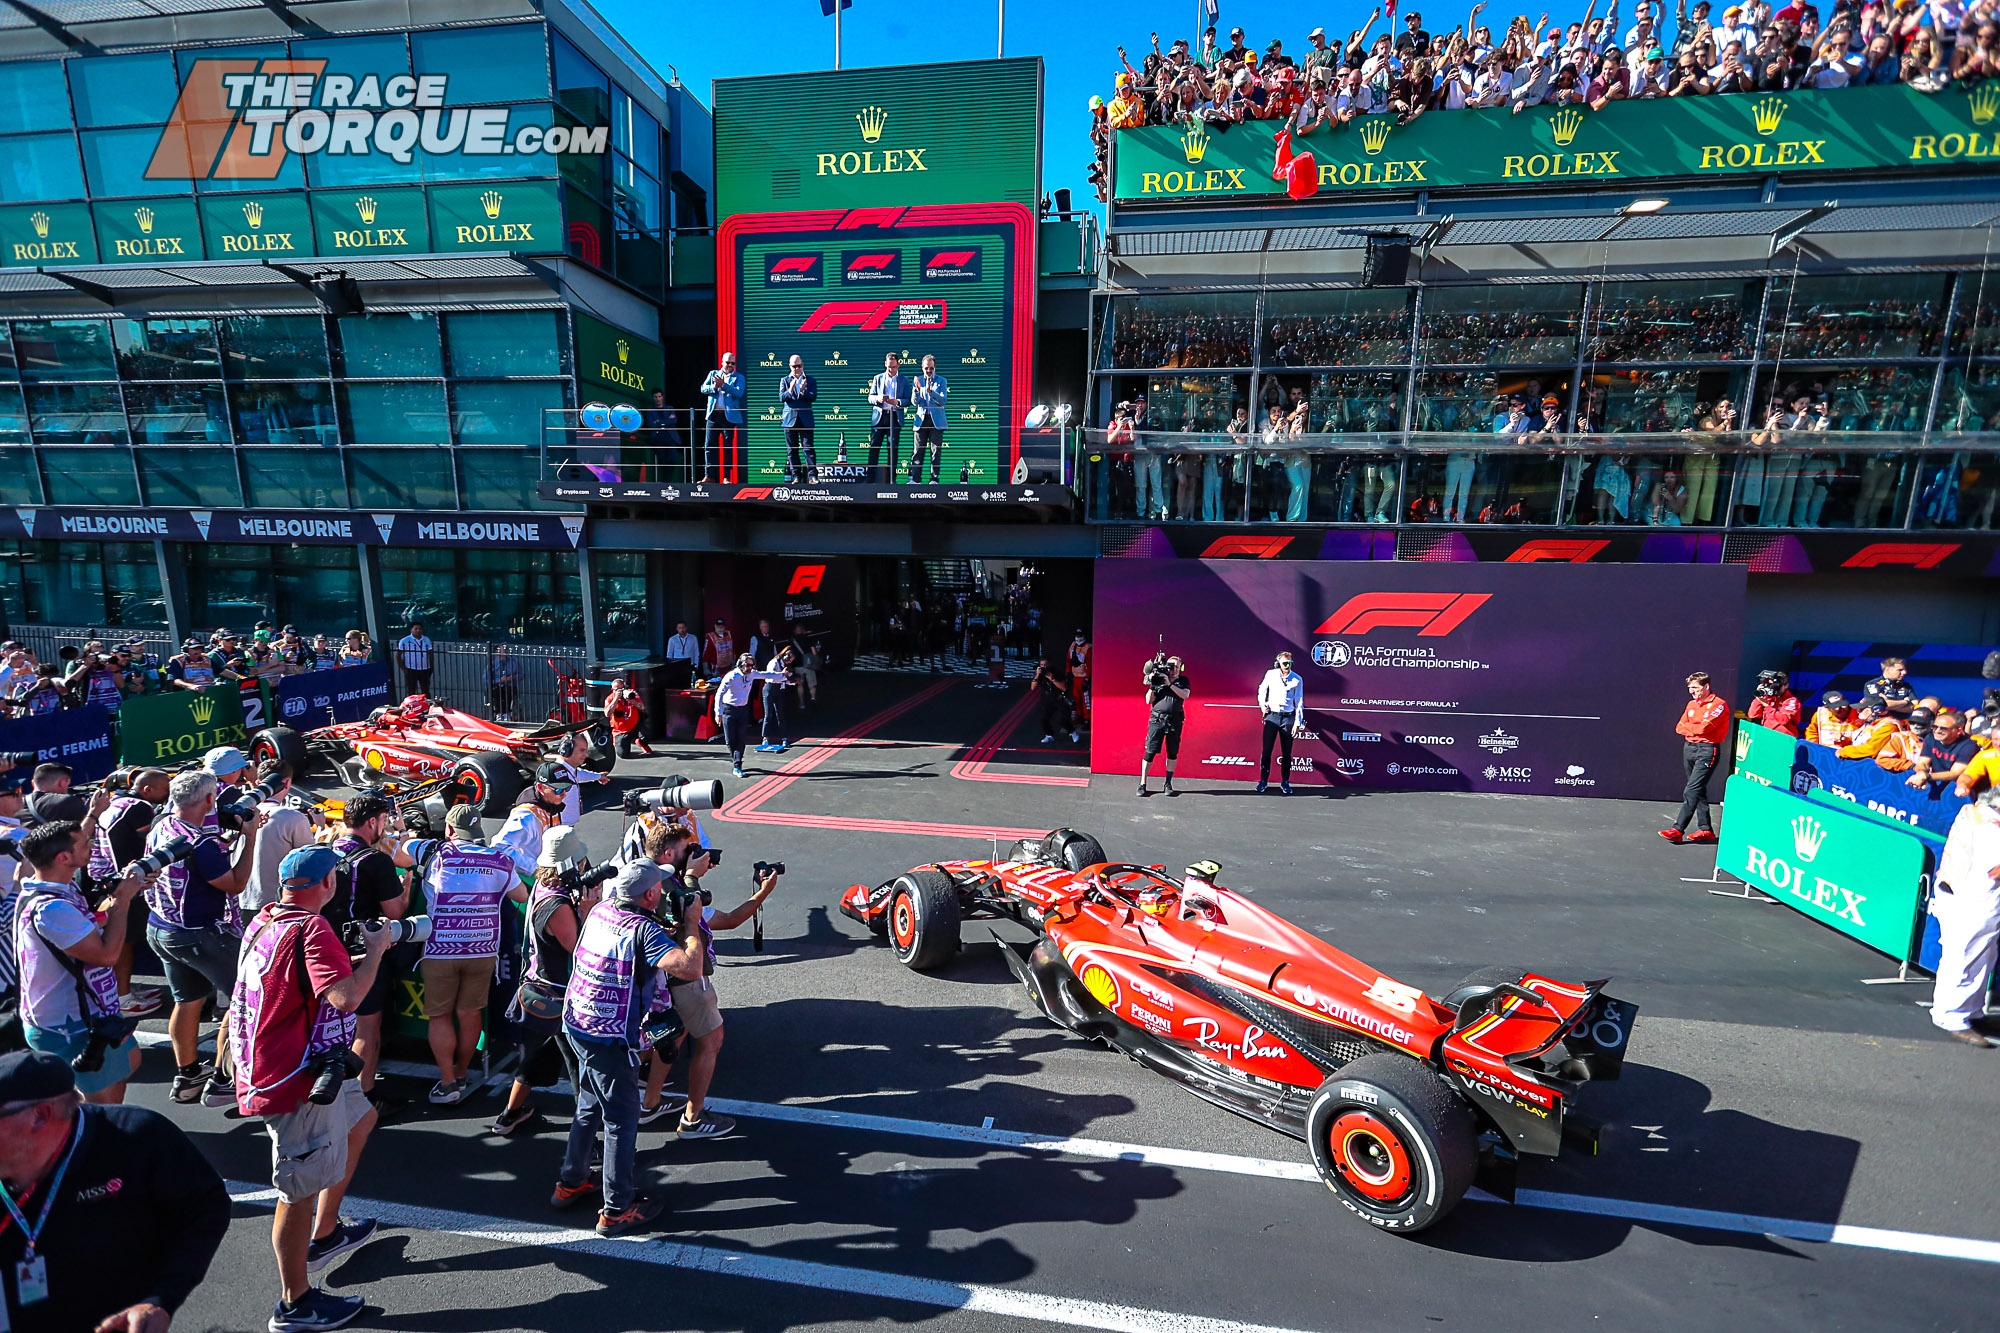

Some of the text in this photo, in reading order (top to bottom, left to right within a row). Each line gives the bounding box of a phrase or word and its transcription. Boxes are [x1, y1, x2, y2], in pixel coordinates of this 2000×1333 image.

[816, 148, 928, 176] ROLEX
[1502, 151, 1620, 178] ROLEX
[1698, 140, 1826, 168] ROLEX
[1141, 168, 1245, 193] ROLEX
[1317, 160, 1428, 185] ROLEX
[221, 233, 295, 254] ROLEX
[333, 227, 409, 250] ROLEX
[457, 223, 534, 244] ROLEX
[13, 241, 80, 261] ROLEX
[115, 237, 185, 258] ROLEX
[600, 361, 645, 391] ROLEX
[817, 466, 868, 476] ERRAR
[61, 516, 169, 534] MELBOURNE
[238, 518, 353, 538] MELBOURNE
[417, 521, 540, 542] MELBOURNE
[1354, 646, 1436, 658] FIA Formula 1
[1354, 656, 1390, 667] World
[338, 682, 388, 702] PARC FERMÉ
[242, 697, 266, 729] 2
[38, 733, 109, 762] RC FERMÉ
[154, 723, 247, 759] ROLEX
[1342, 732, 1382, 742] PIRELLI
[1404, 735, 1454, 745] aramco
[1276, 756, 1313, 766] QTAR
[1336, 758, 1364, 768] aws
[1402, 766, 1458, 776] crypto.com
[1500, 767, 1532, 778] MSC
[1554, 777, 1595, 786] salesforce
[1745, 845, 1868, 927] ROLEX
[457, 918, 494, 927] MEDIA
[1147, 997, 1174, 1012] LOGISTICS
[1361, 976, 1423, 1013] 55
[1131, 1002, 1172, 1029] PERONI
[1317, 995, 1414, 1045] Santander
[1183, 1017, 1288, 1060] Ray-Ban
[1255, 1076, 1282, 1090] MAHLE
[1290, 1086, 1314, 1098] brem
[1471, 1067, 1548, 1104] V-Power
[1340, 1087, 1379, 1105] PIRELLI
[1459, 1074, 1548, 1119] VGW PLAY
[1341, 1199, 1400, 1228] ZERO
